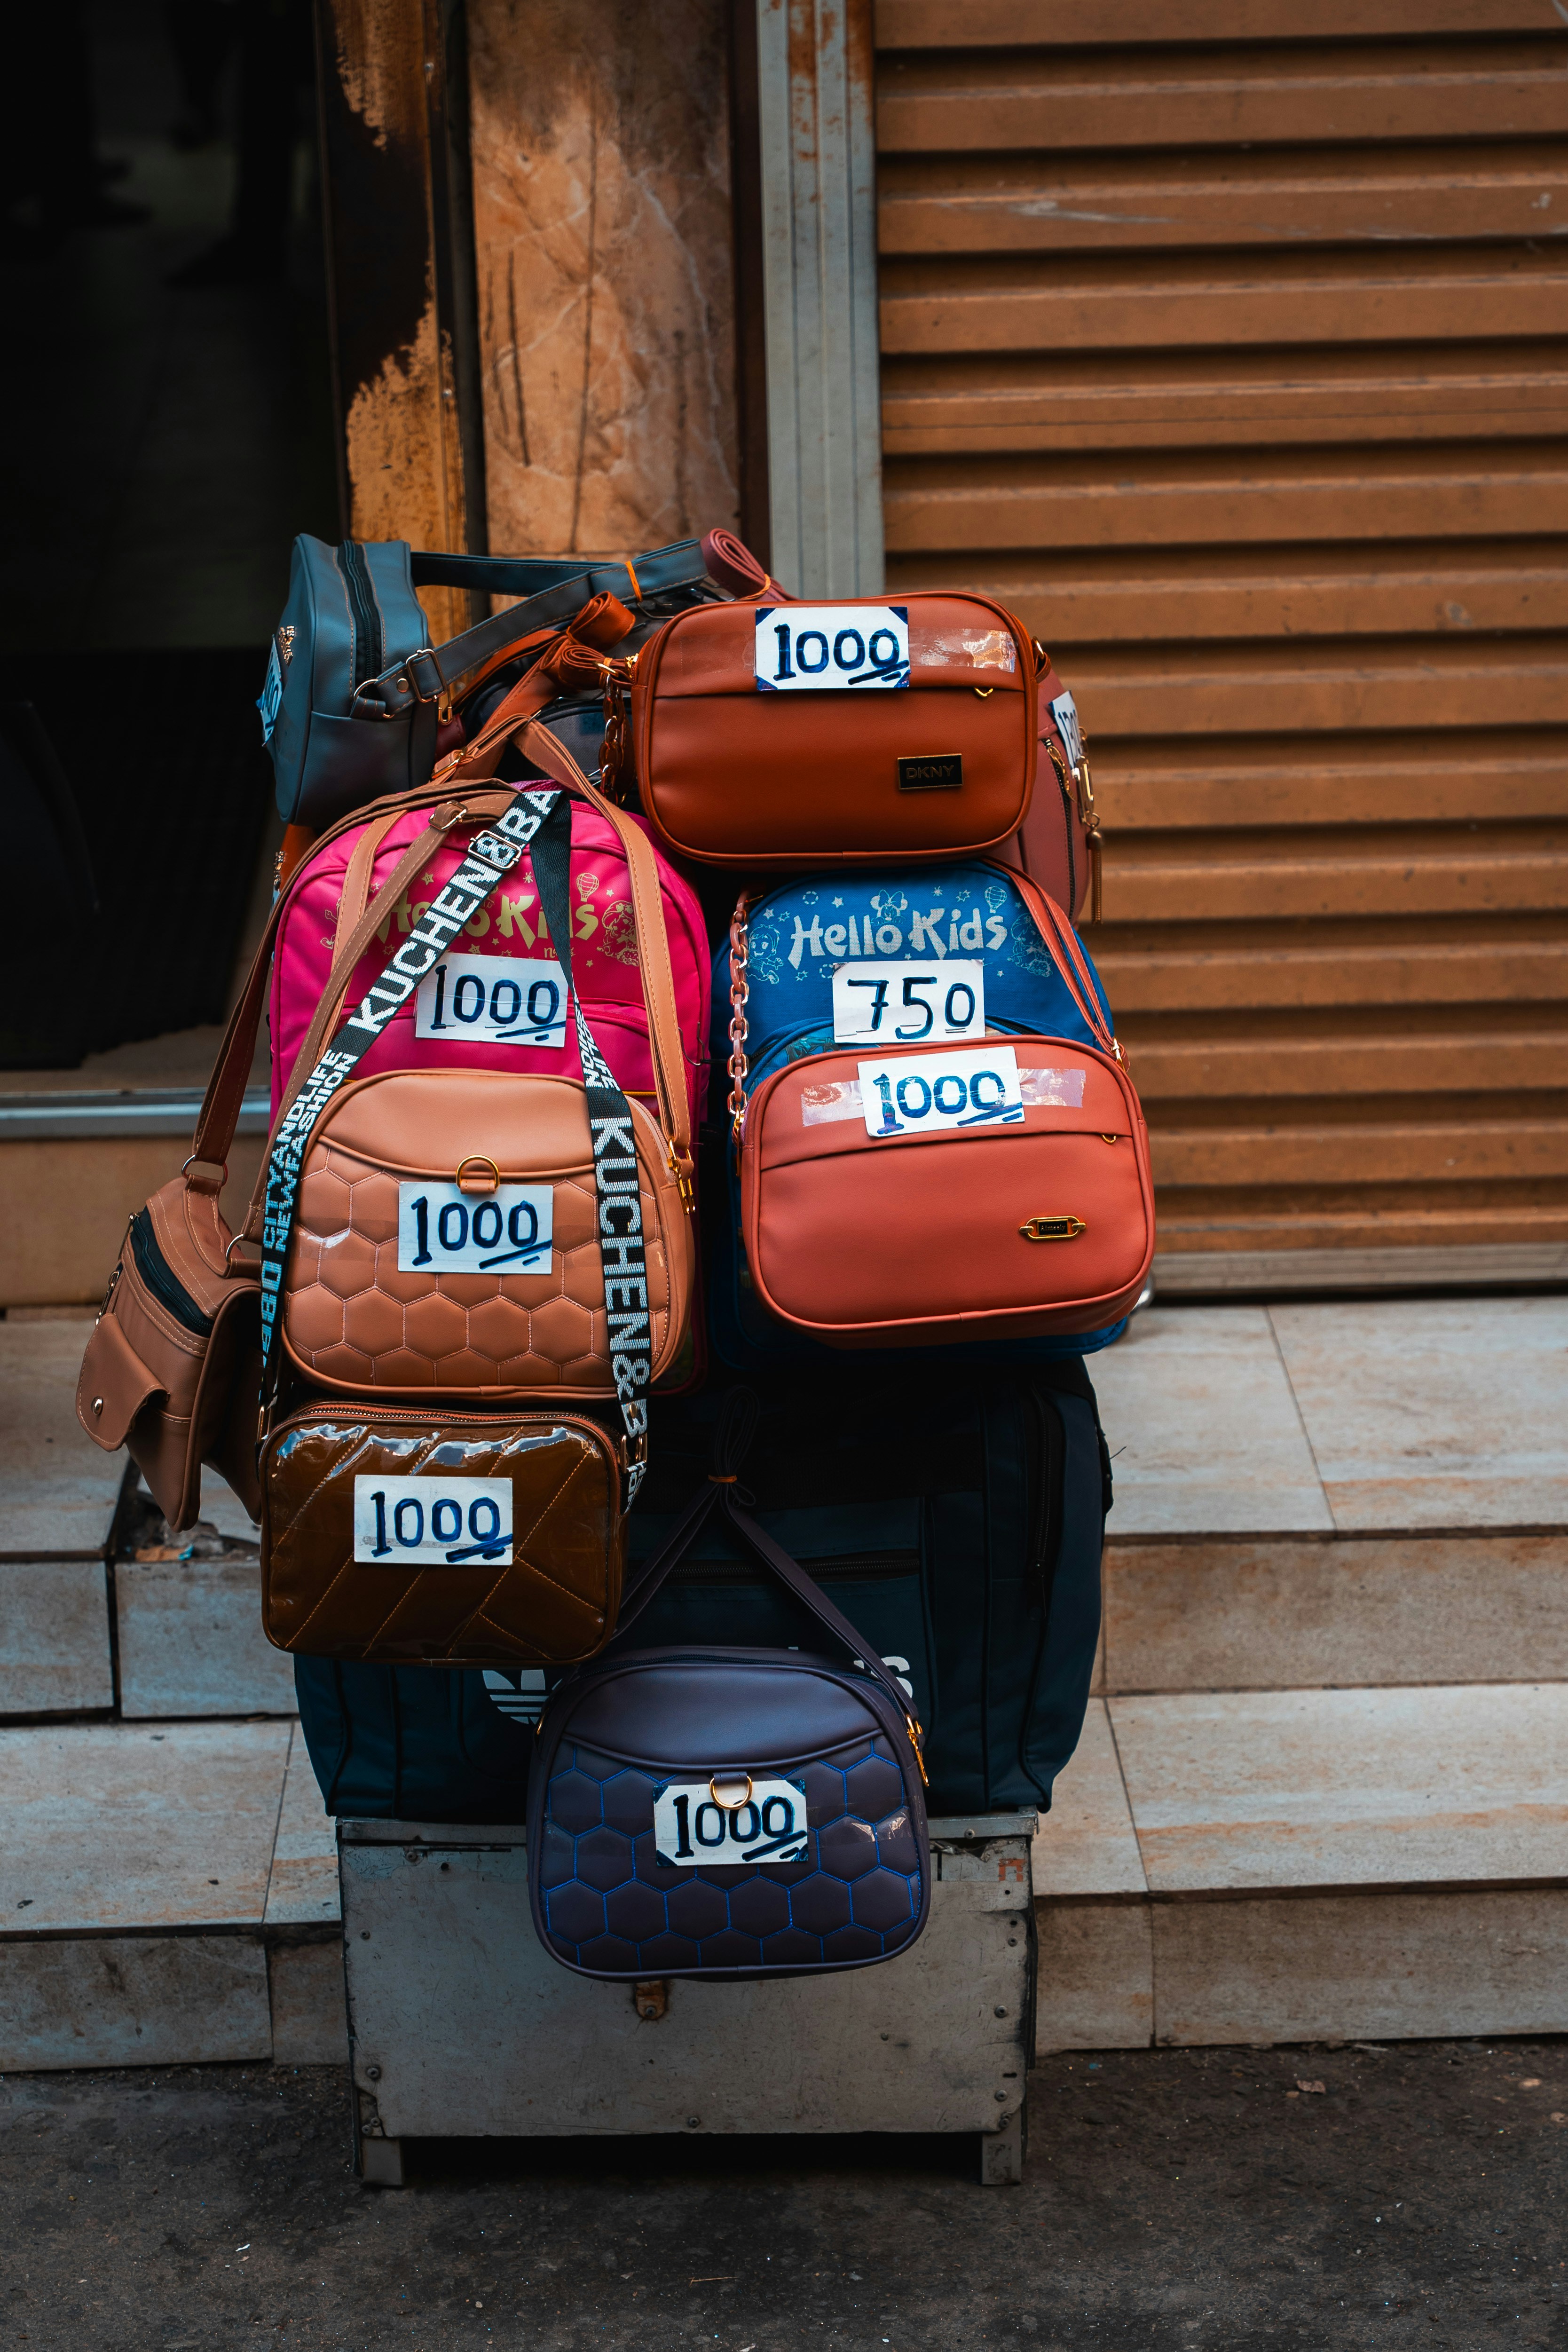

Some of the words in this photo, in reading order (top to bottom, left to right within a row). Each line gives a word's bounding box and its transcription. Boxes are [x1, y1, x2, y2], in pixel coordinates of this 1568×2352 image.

[773, 624, 900, 681] 1000
[906, 765, 954, 780] DKNY
[495, 894, 599, 950] Kis
[788, 914, 903, 970] Hello
[908, 908, 1008, 960] Kids
[431, 964, 559, 1030] 1000
[847, 976, 976, 1040] 750
[873, 1070, 1007, 1135] 1000
[411, 1196, 538, 1266] 1000
[370, 1491, 500, 1558] 1000
[673, 1794, 795, 1859] 1000
